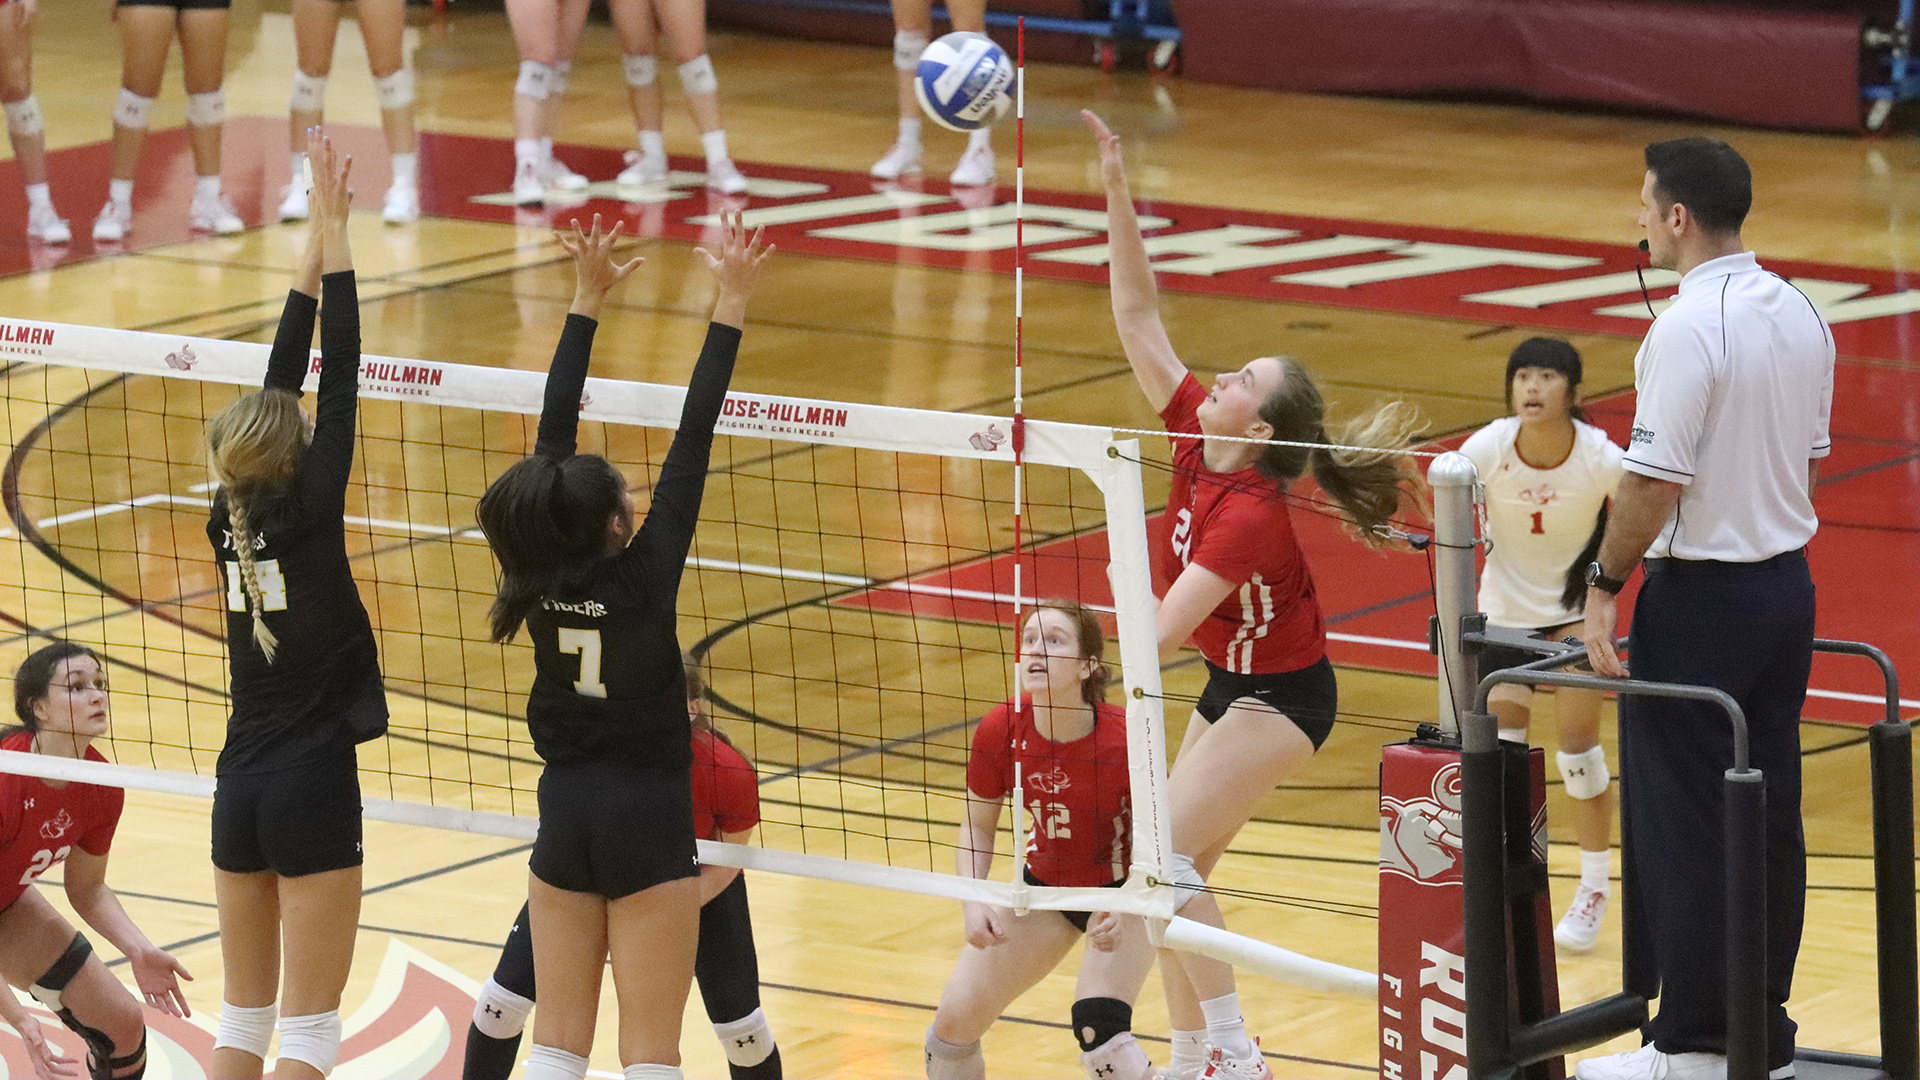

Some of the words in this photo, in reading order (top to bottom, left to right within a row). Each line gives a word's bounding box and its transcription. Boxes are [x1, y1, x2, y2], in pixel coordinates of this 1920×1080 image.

[310, 357, 443, 386] R-HULMAN
[369, 384, 430, 396] ENGINEERS
[722, 399, 848, 427] OSE-HULMAN
[771, 426, 835, 438] ENGINEERS
[1530, 511, 1544, 535] 1
[558, 627, 608, 699] 7
[1029, 799, 1072, 839] 12
